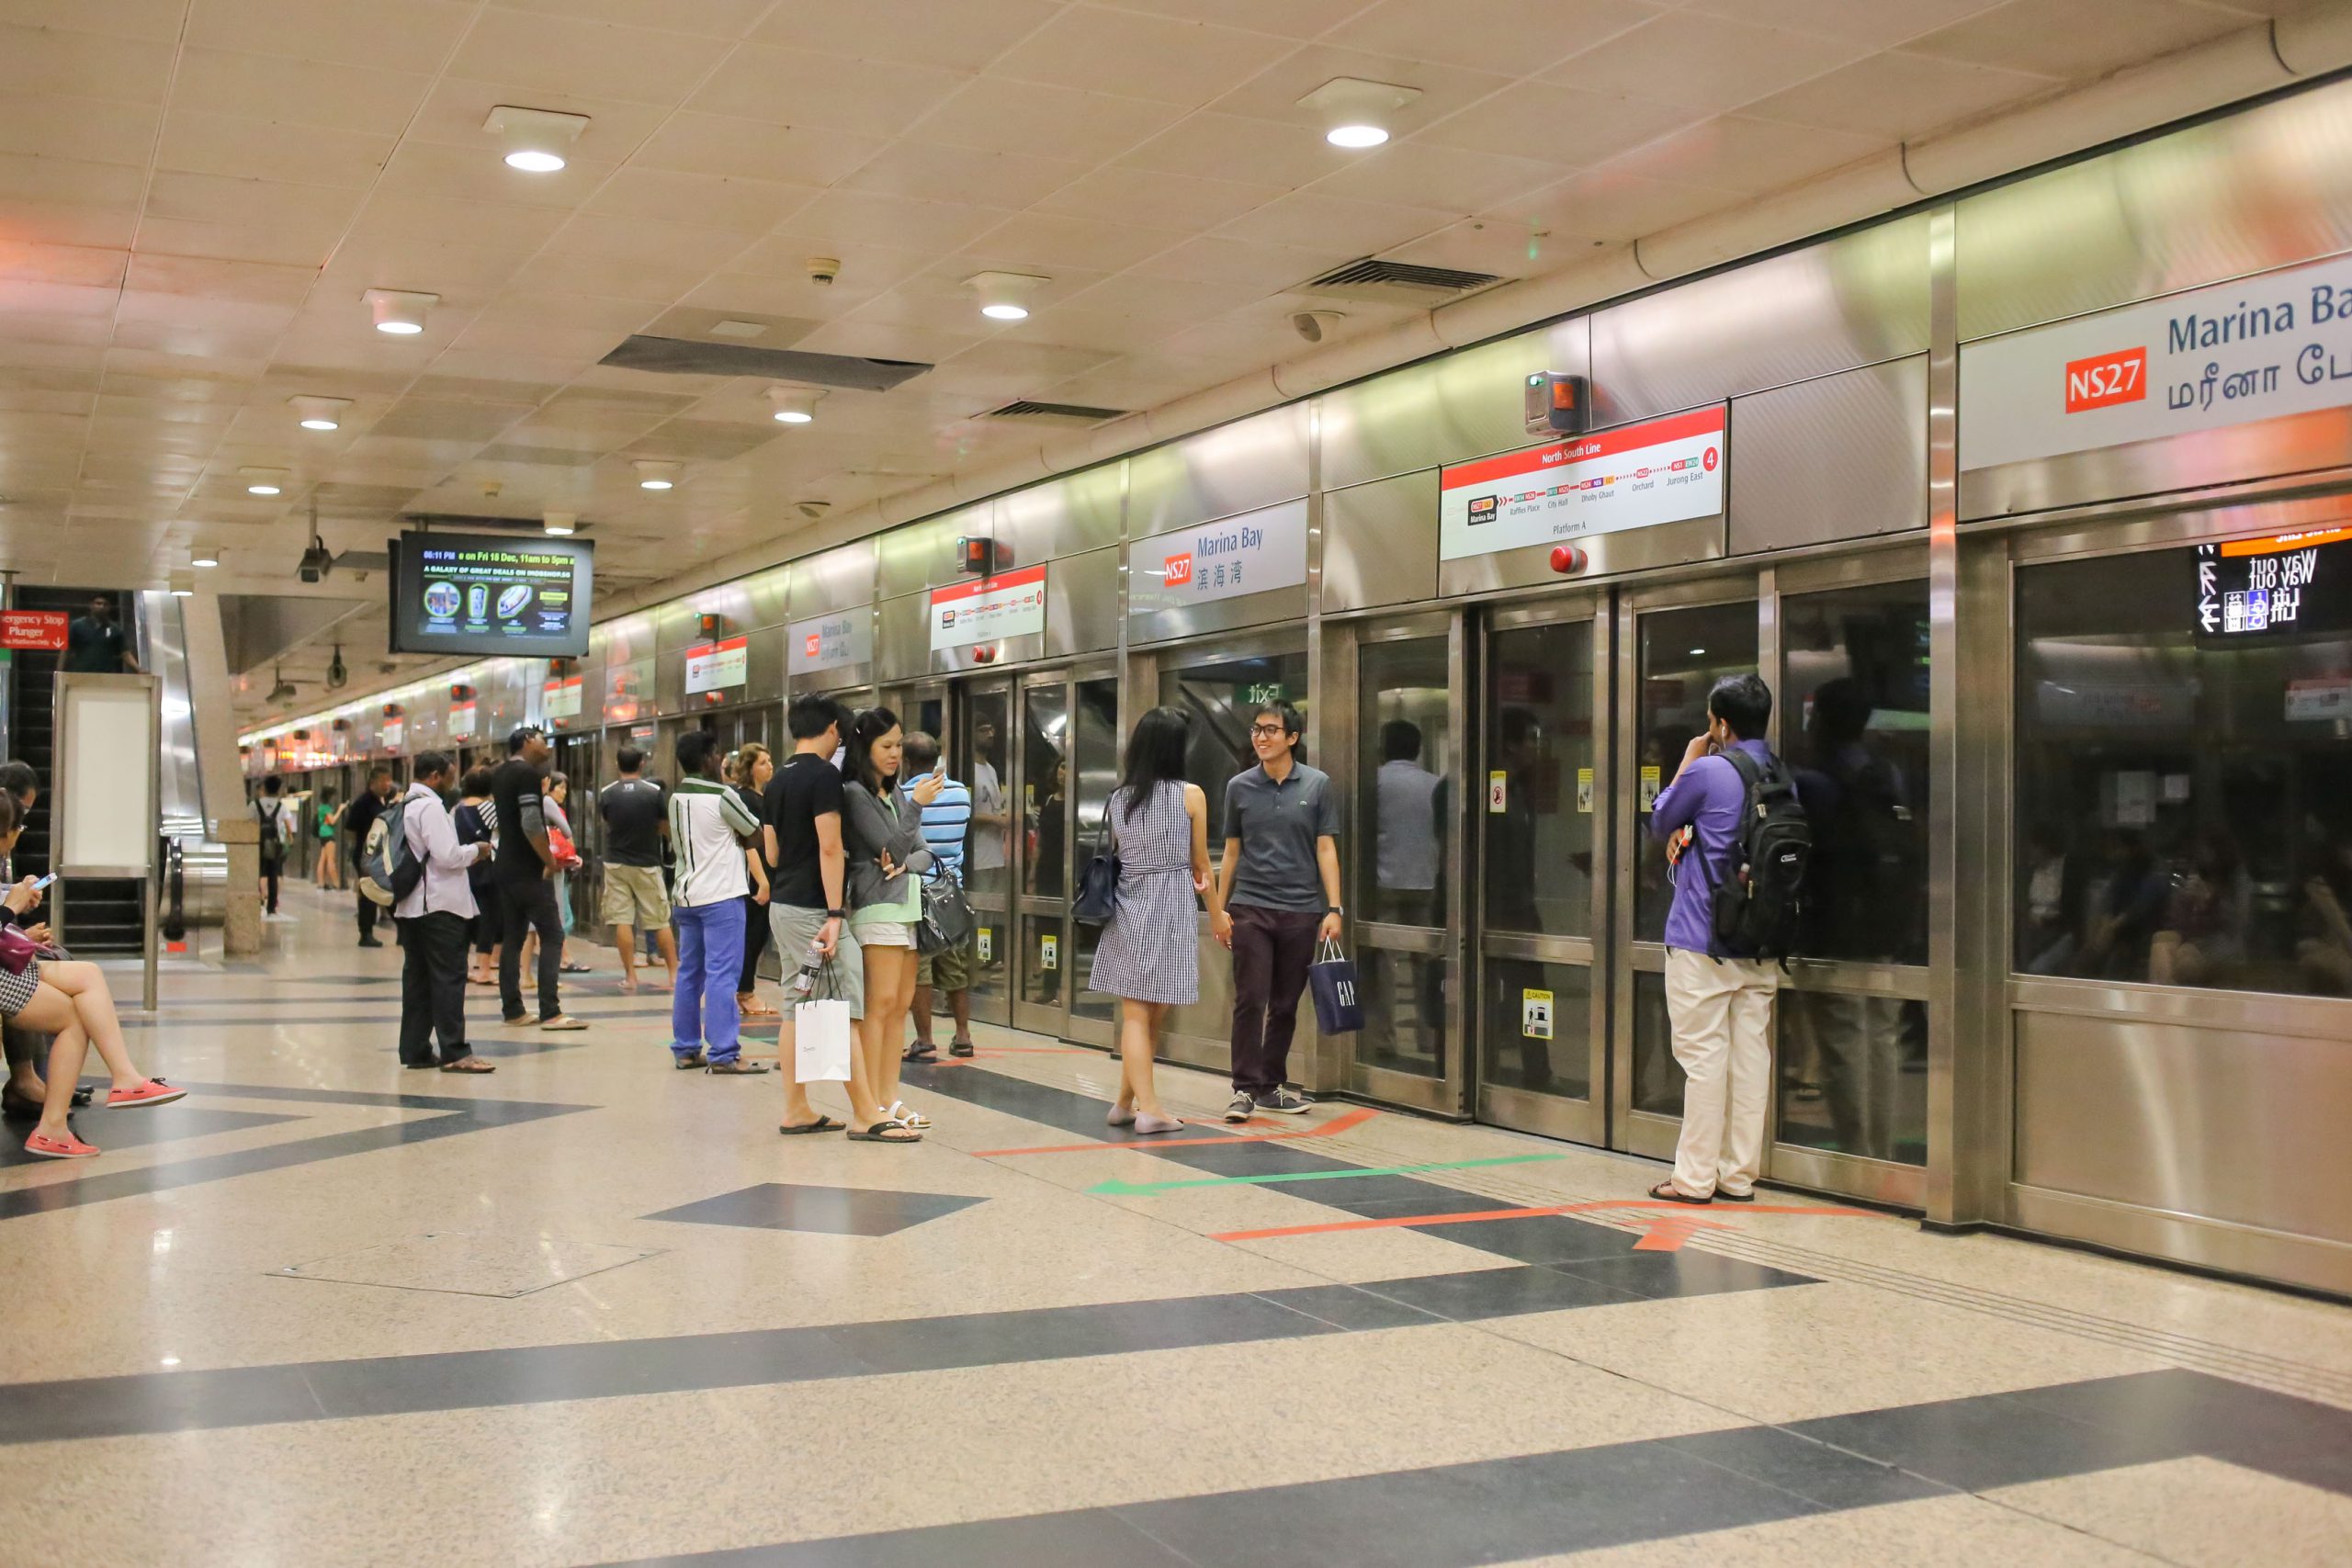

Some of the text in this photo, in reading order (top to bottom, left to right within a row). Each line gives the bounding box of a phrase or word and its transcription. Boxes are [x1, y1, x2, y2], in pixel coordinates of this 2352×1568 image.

[2168, 299, 2294, 355] Marina
[2069, 358, 2142, 402] NS27
[2168, 361, 2281, 412] மரீனா
[1542, 443, 1601, 464] North South Line
[1706, 452, 1714, 467] 4
[1632, 480, 1654, 492] Orchard
[1667, 471, 1703, 487] Jurong East
[1547, 498, 1568, 508] City Hall
[1581, 490, 1614, 503] Dhoby Ghaut
[1510, 504, 1541, 515] Raffles Place
[1470, 513, 1496, 524] Marina Bay
[1553, 521, 1587, 535] Platform A
[1197, 526, 1263, 558] Marina Bay
[465, 553, 476, 561] on
[477, 551, 488, 561] Fri
[500, 553, 519, 564] Dec,
[520, 553, 540, 564] 11am
[541, 555, 550, 564] to
[424, 565, 430, 573] A
[430, 566, 458, 574] GALAXY
[469, 567, 492, 575] GREAT
[492, 568, 514, 576] DEALS
[515, 569, 526, 577] ON
[1165, 558, 1190, 581] NS27
[1197, 559, 1243, 591] 滨海湾
[43, 615, 64, 626] Stop
[8, 626, 44, 638] Plunger
[1337, 980, 1355, 1008] GAP
[1531, 991, 1551, 1000] CAUTION
